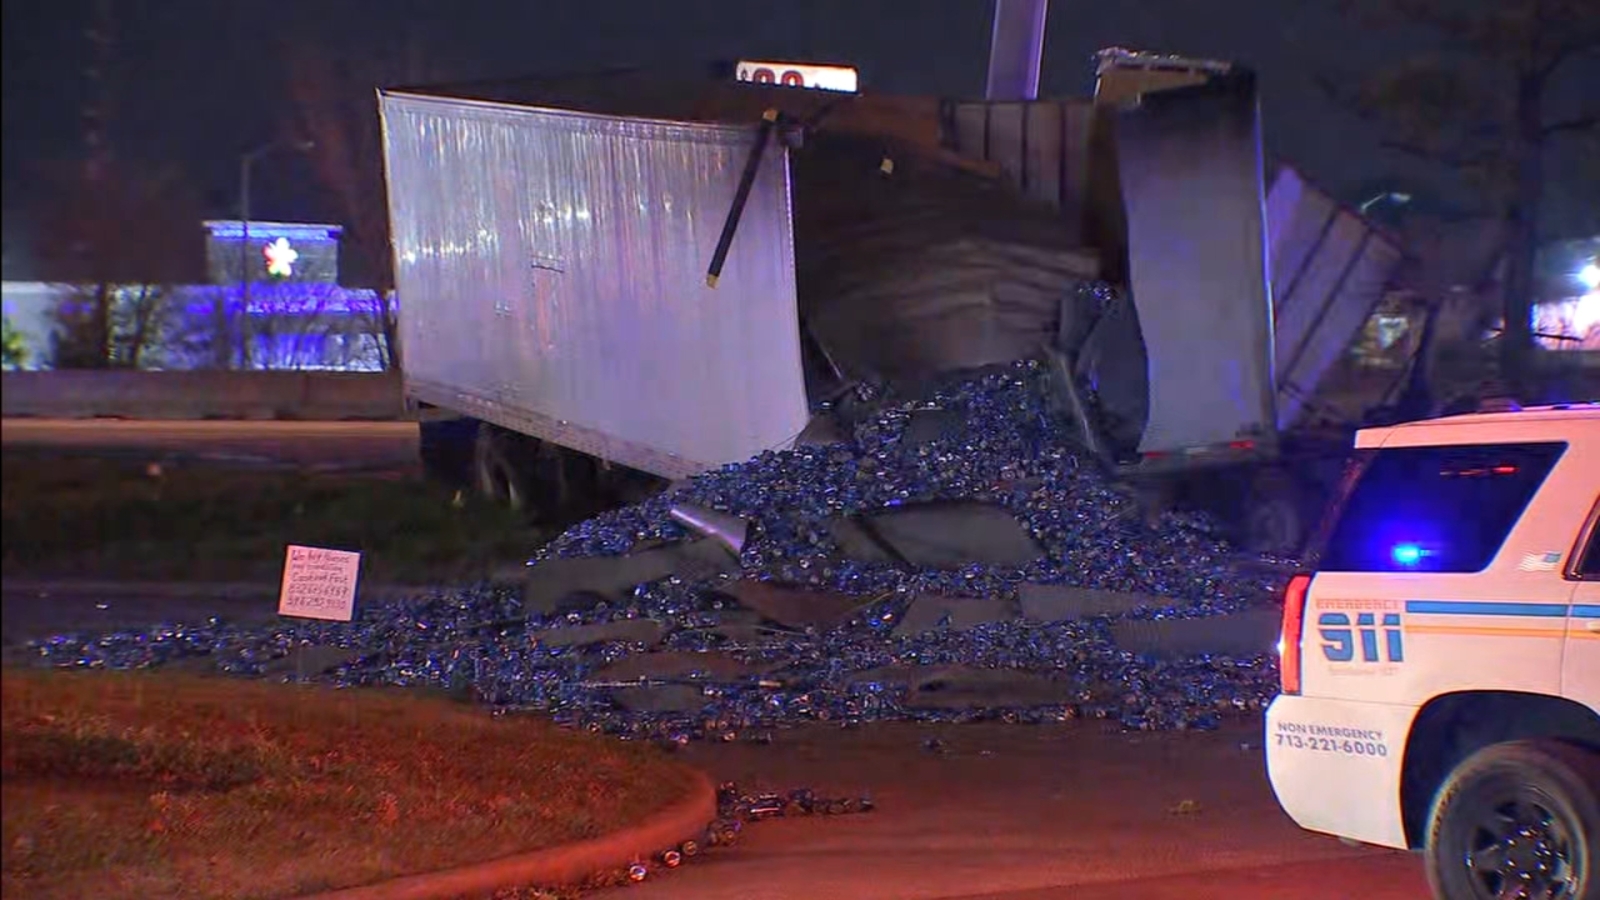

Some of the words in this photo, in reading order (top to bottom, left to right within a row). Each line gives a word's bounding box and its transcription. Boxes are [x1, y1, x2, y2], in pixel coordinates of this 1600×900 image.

[1317, 612, 1404, 663] 911
[1277, 722, 1307, 734] NON
[1309, 725, 1383, 741] EMERGENCY
[1275, 733, 1388, 757] 713-221-6000
